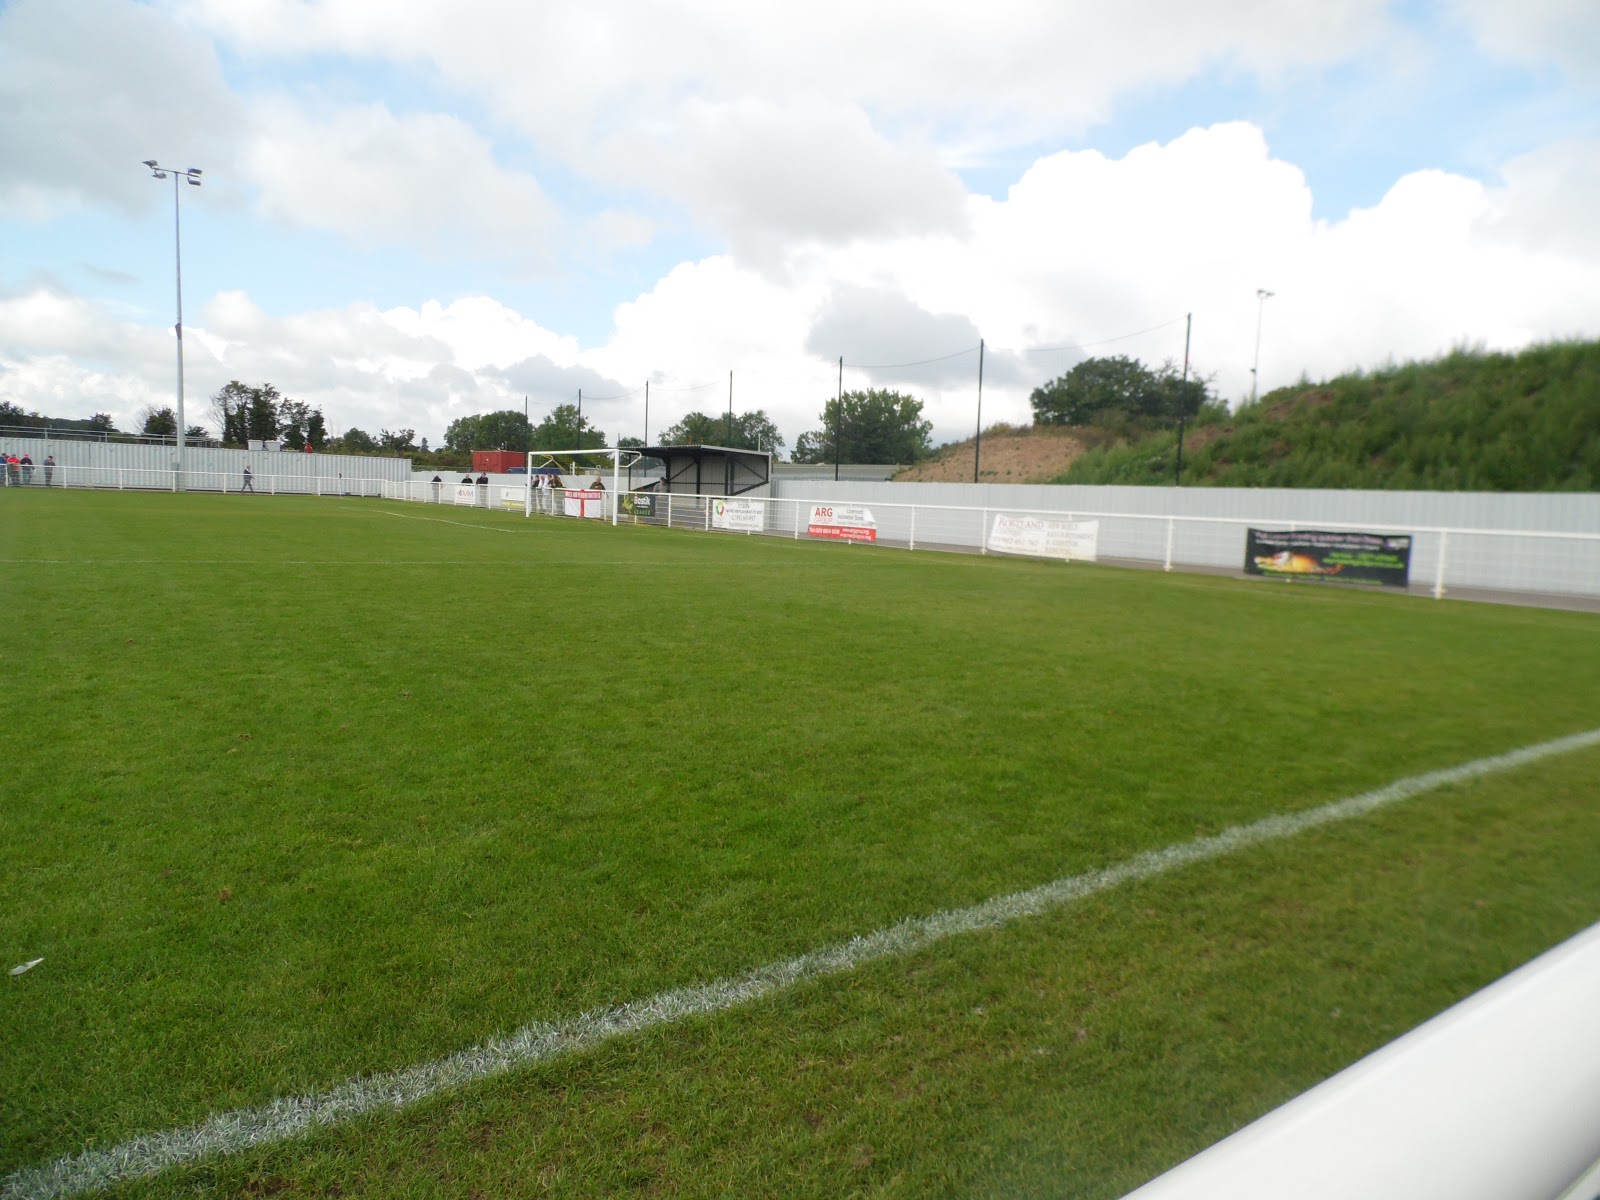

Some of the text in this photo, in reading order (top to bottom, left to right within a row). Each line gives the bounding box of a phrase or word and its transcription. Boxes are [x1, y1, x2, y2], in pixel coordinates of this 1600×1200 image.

[633, 495, 651, 505] Bostik
[633, 508, 651, 516] LEAGUE
[814, 507, 833, 517] ARG
[813, 517, 833, 525] GROUP
